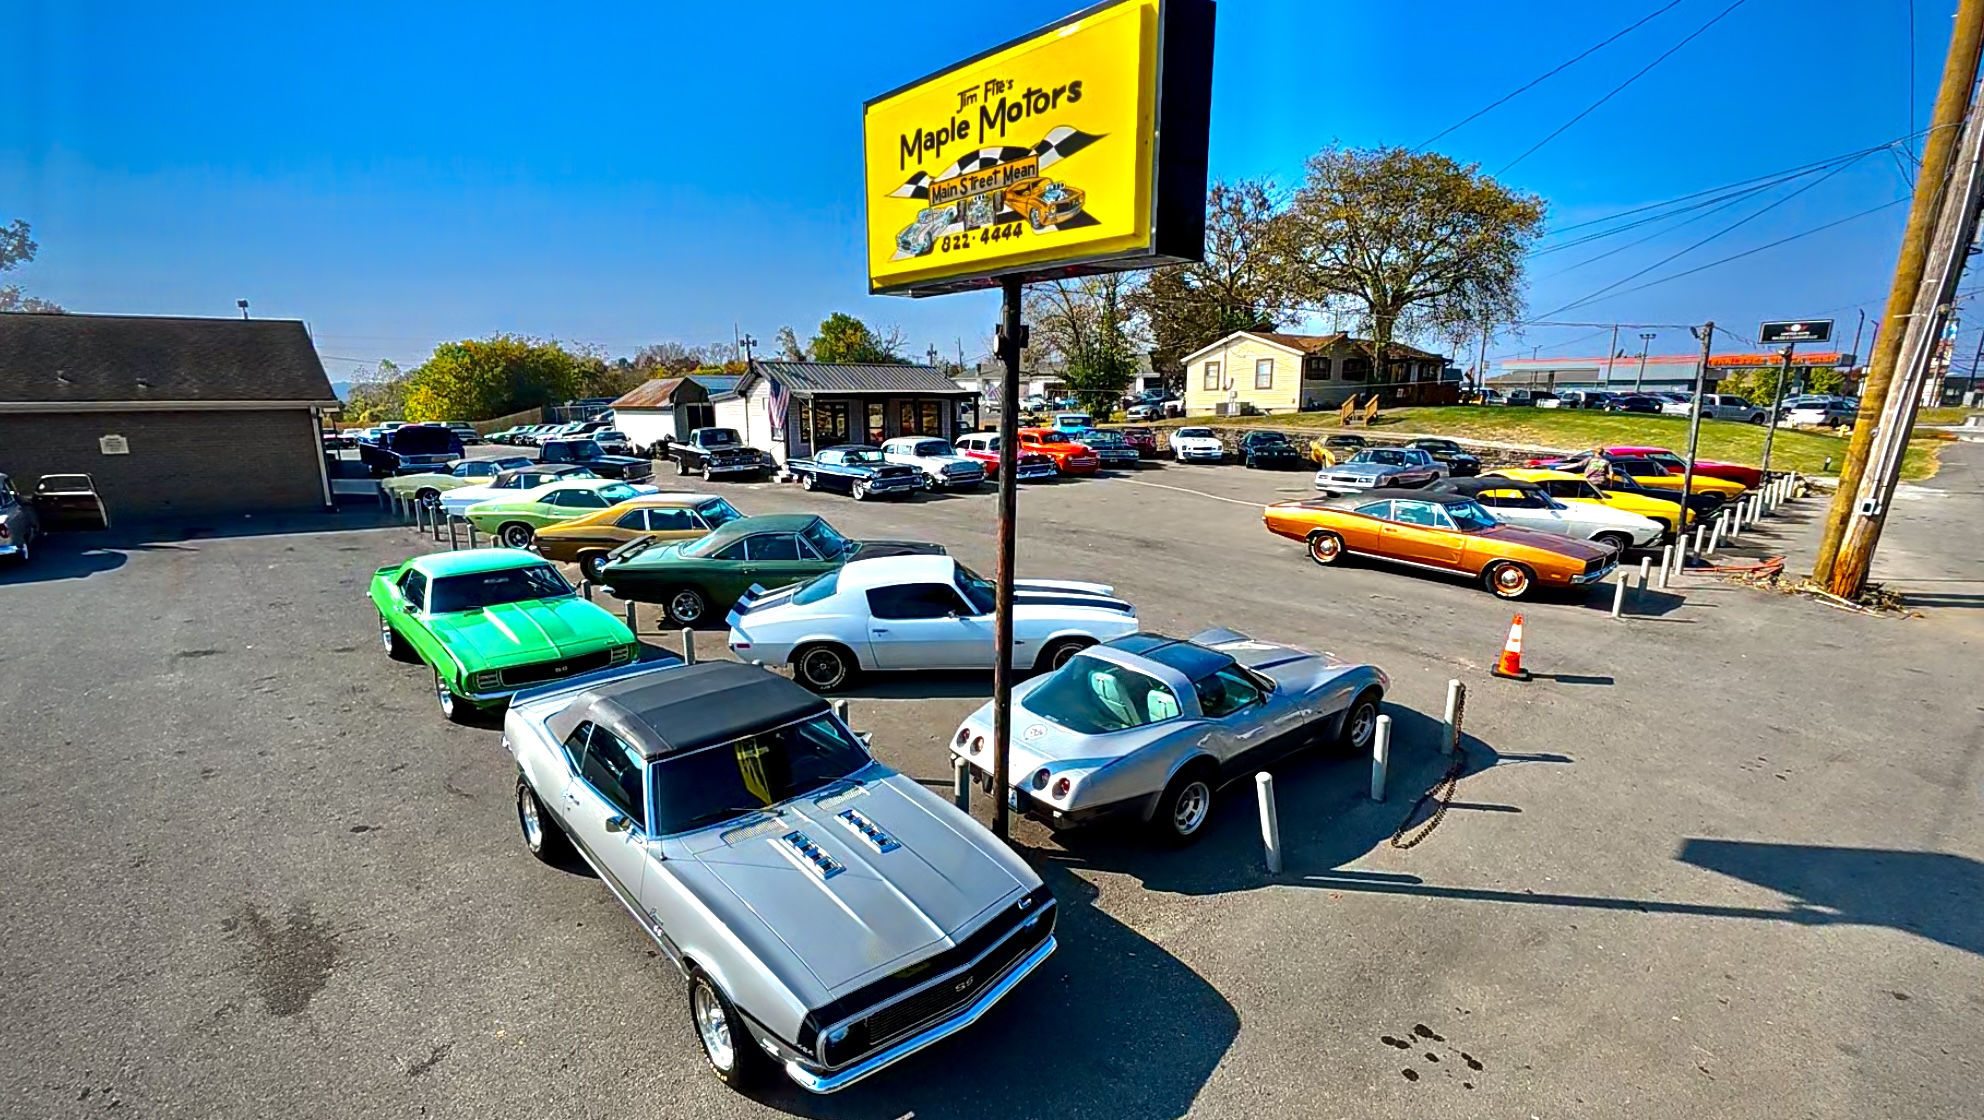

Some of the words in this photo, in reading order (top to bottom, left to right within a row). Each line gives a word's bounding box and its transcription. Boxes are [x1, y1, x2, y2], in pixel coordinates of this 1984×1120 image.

[957, 85, 980, 114] Jim
[900, 115, 970, 171] Maple
[979, 80, 1083, 144] Motors
[932, 183, 958, 204] Main
[960, 169, 1001, 197] Street
[1003, 163, 1036, 185] Mean
